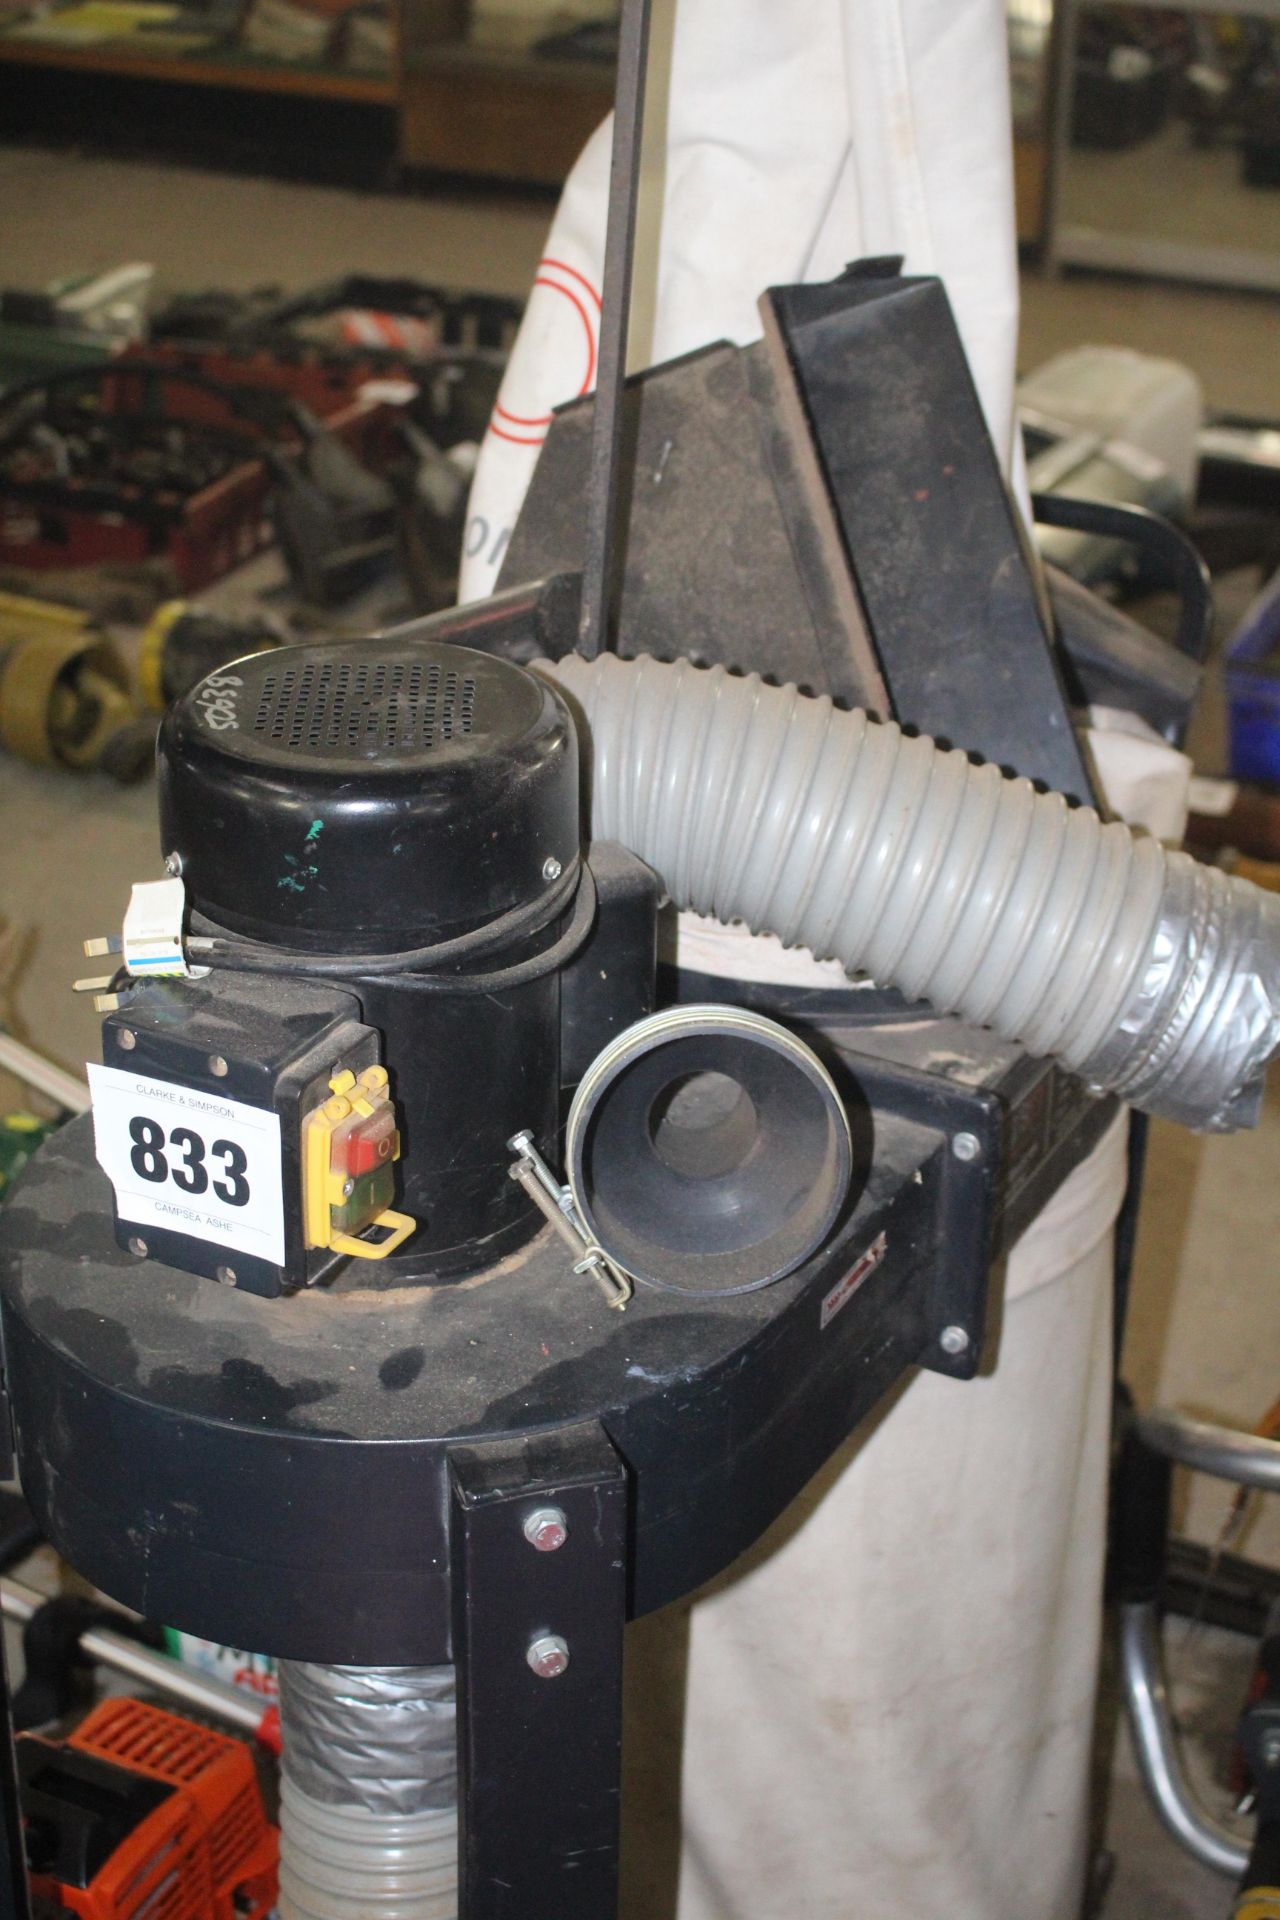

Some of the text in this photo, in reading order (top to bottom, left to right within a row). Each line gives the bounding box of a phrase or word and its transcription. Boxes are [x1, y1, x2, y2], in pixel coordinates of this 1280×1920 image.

[136, 1084, 235, 1119] CLARKE & SIMPSON
[129, 1116, 250, 1207] 833
[154, 1201, 233, 1232] CAMPSEA ASHE
